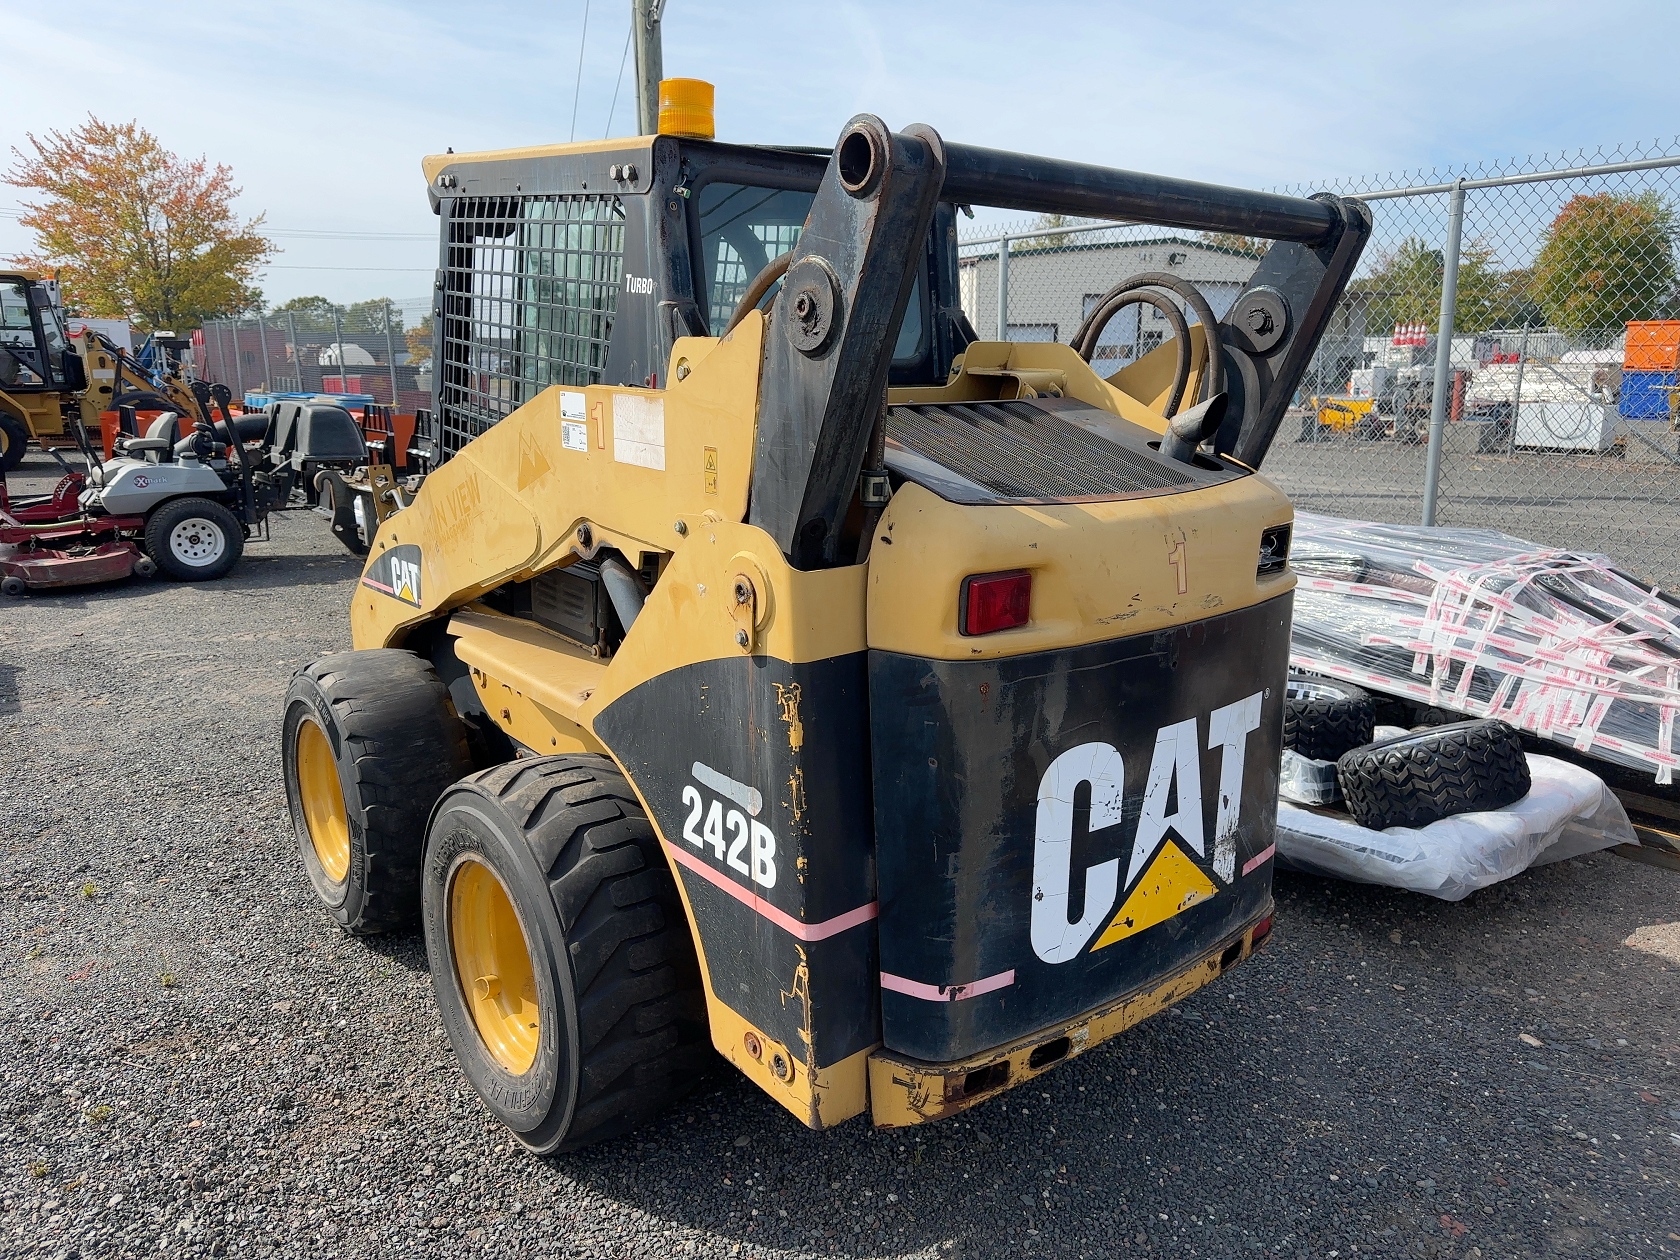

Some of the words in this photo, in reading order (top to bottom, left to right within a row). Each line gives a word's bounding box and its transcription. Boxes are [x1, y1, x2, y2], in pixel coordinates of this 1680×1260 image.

[591, 401, 606, 450] 1
[391, 556, 418, 604] CAT
[1168, 542, 1187, 595] 1
[682, 785, 777, 889] 242B
[1031, 691, 1263, 964] CAT
